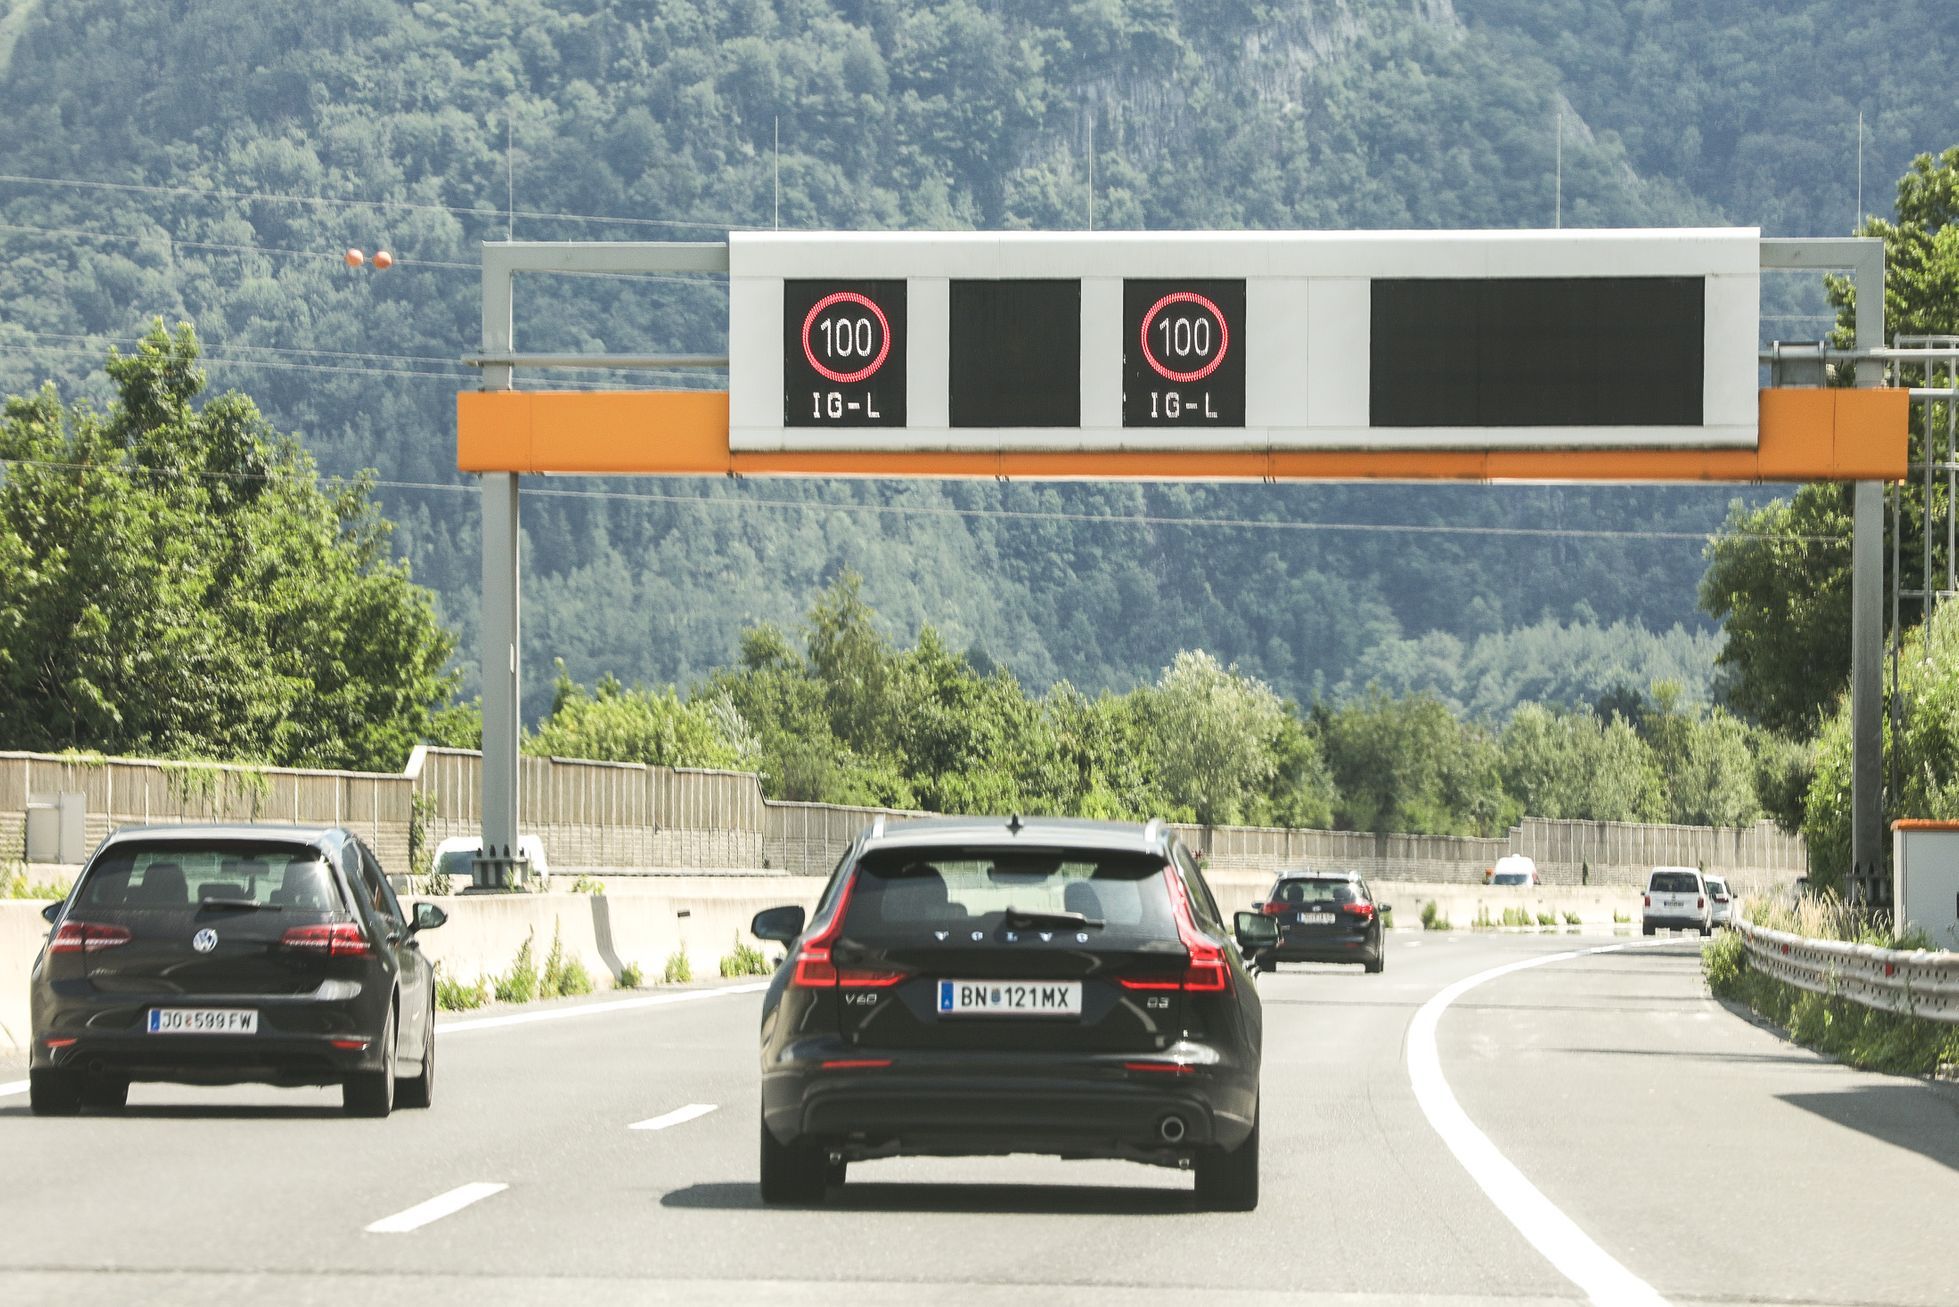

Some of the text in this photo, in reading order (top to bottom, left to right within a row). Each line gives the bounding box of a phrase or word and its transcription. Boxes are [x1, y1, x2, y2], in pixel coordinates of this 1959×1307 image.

[821, 318, 872, 357] 100
[1159, 317, 1209, 357] 100
[813, 392, 880, 418] IG-L
[1151, 392, 1218, 418] IG-L
